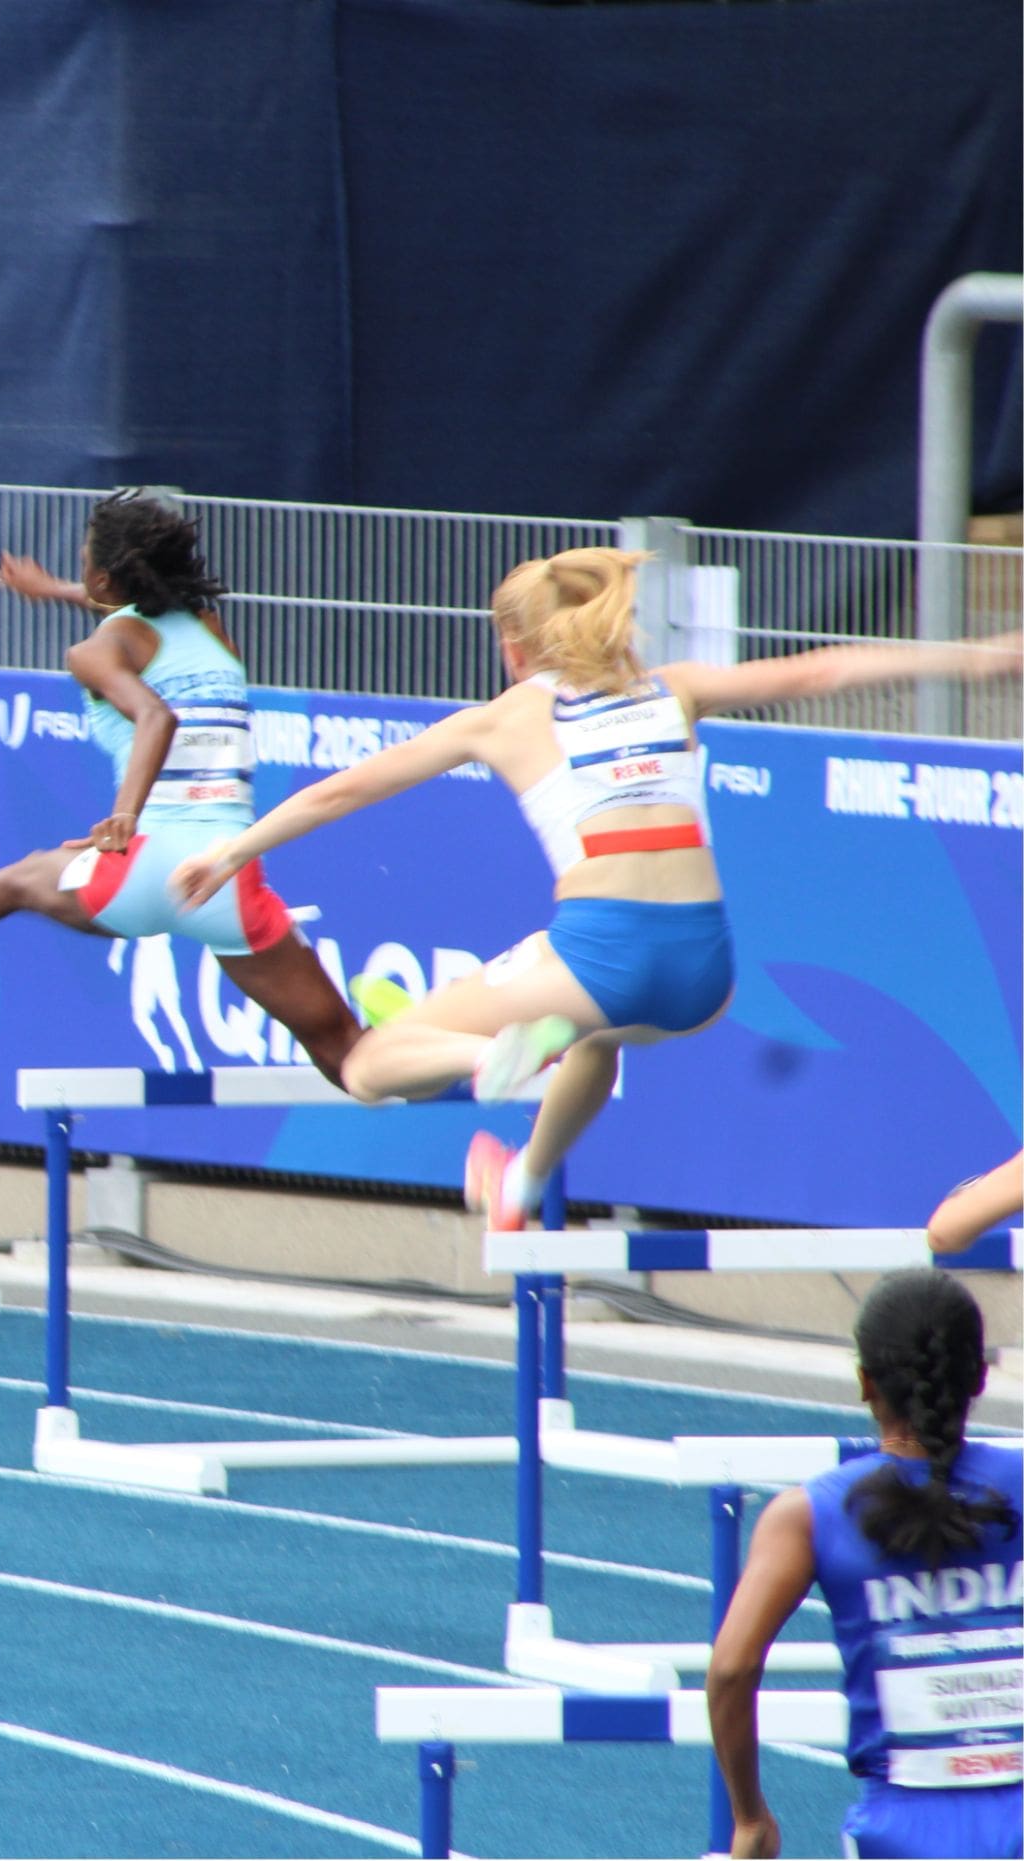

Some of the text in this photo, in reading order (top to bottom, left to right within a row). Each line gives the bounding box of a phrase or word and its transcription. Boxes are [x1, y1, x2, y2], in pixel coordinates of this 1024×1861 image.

[33, 709, 90, 742] FISU
[312, 714, 382, 770] 2025
[612, 759, 664, 781] REWE
[709, 762, 771, 797] FISU
[826, 757, 992, 827] RHINE-RUHR
